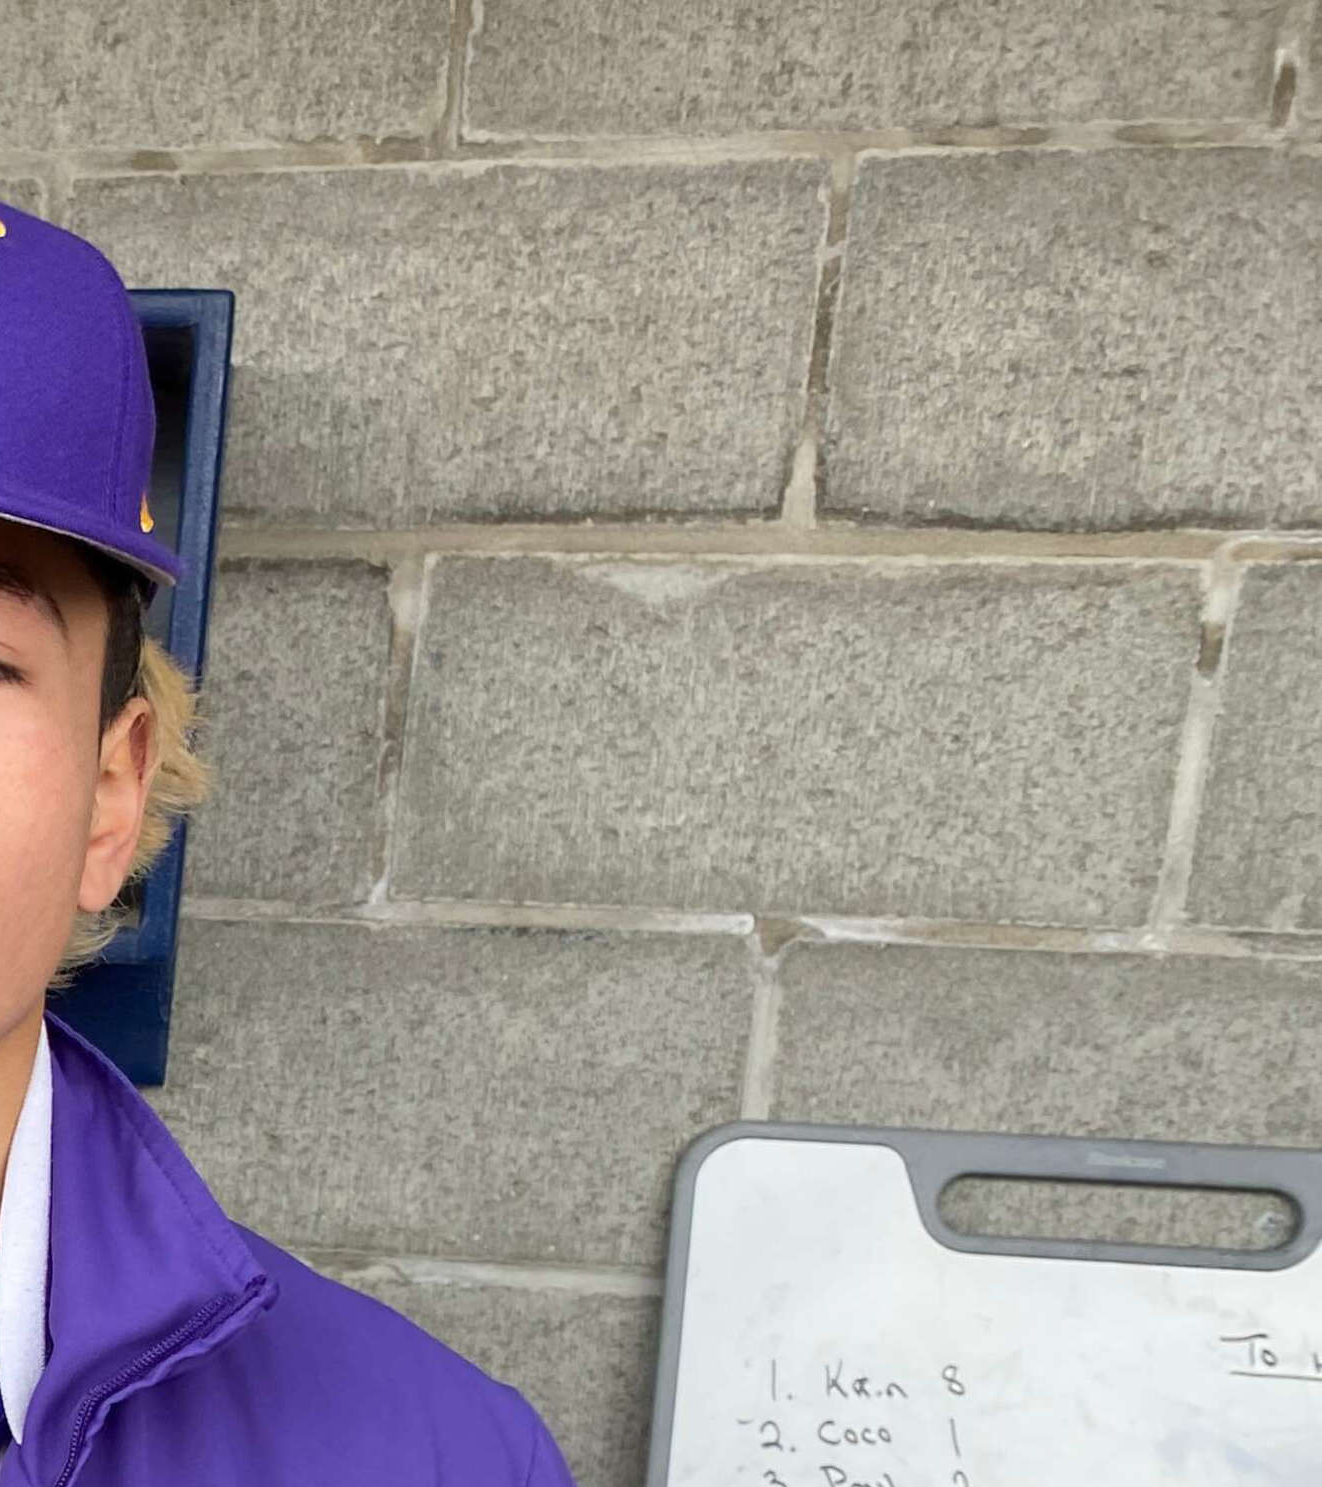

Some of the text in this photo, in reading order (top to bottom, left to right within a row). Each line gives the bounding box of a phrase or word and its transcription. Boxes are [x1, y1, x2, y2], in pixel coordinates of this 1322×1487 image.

[942, 1364, 966, 1397] 8
[759, 1420, 798, 1453] 2.
[817, 1420, 892, 1446] Coco
